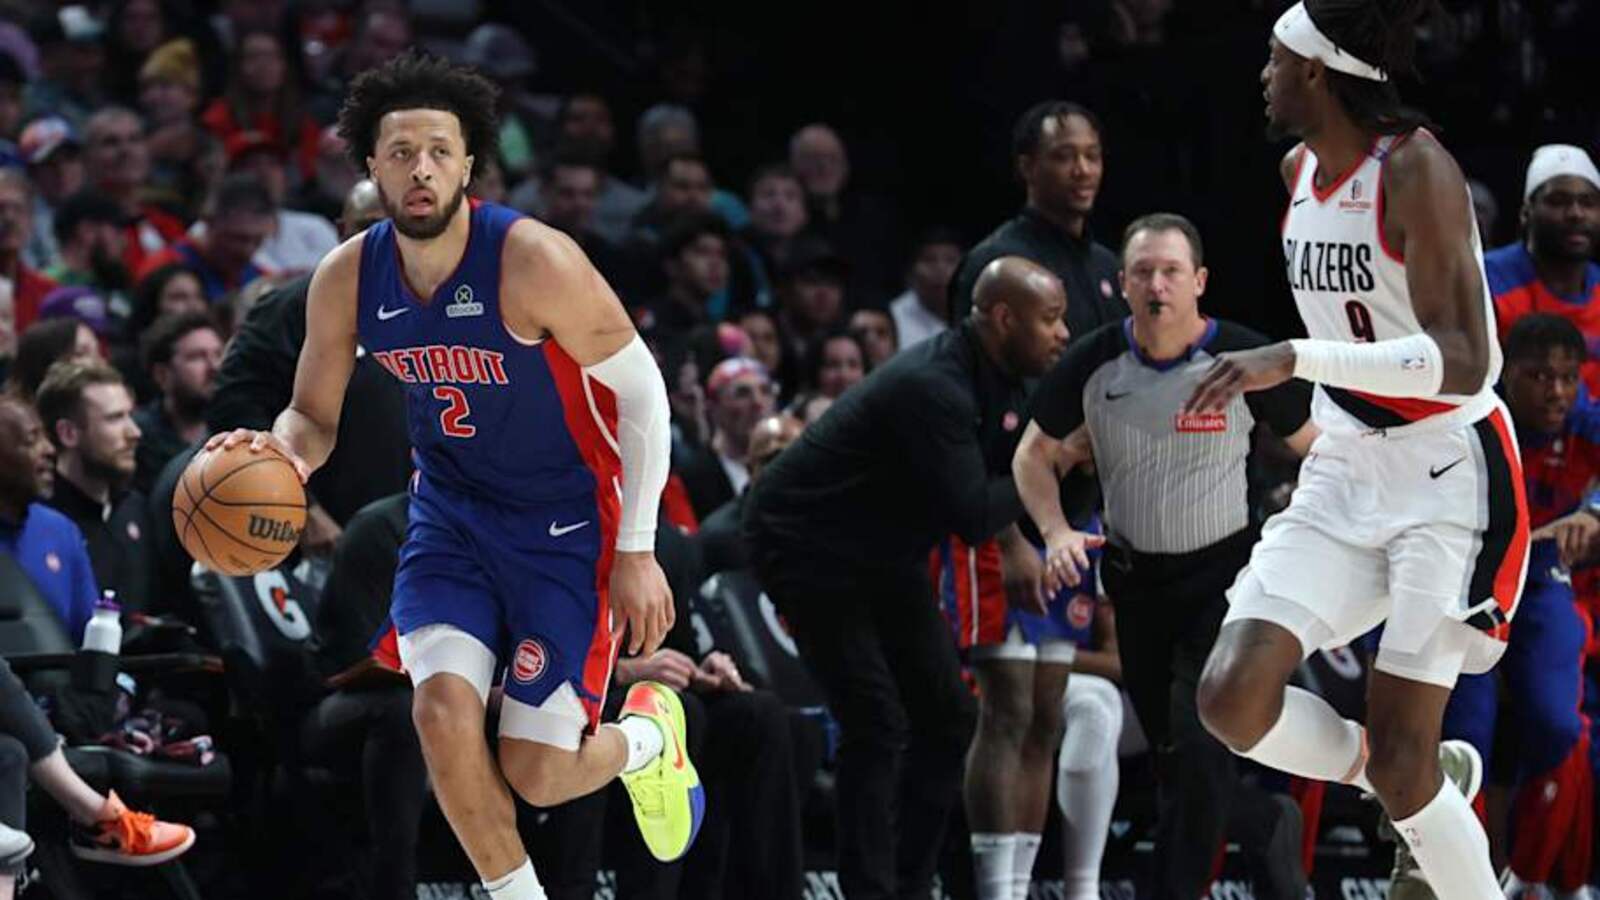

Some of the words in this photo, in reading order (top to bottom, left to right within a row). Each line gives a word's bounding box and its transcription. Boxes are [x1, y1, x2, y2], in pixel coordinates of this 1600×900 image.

[1285, 239, 1375, 293] LAZERS
[1345, 300, 1376, 343] 9
[433, 386, 476, 437] 2
[1177, 416, 1225, 428] Emirates
[248, 513, 300, 543] Wils
